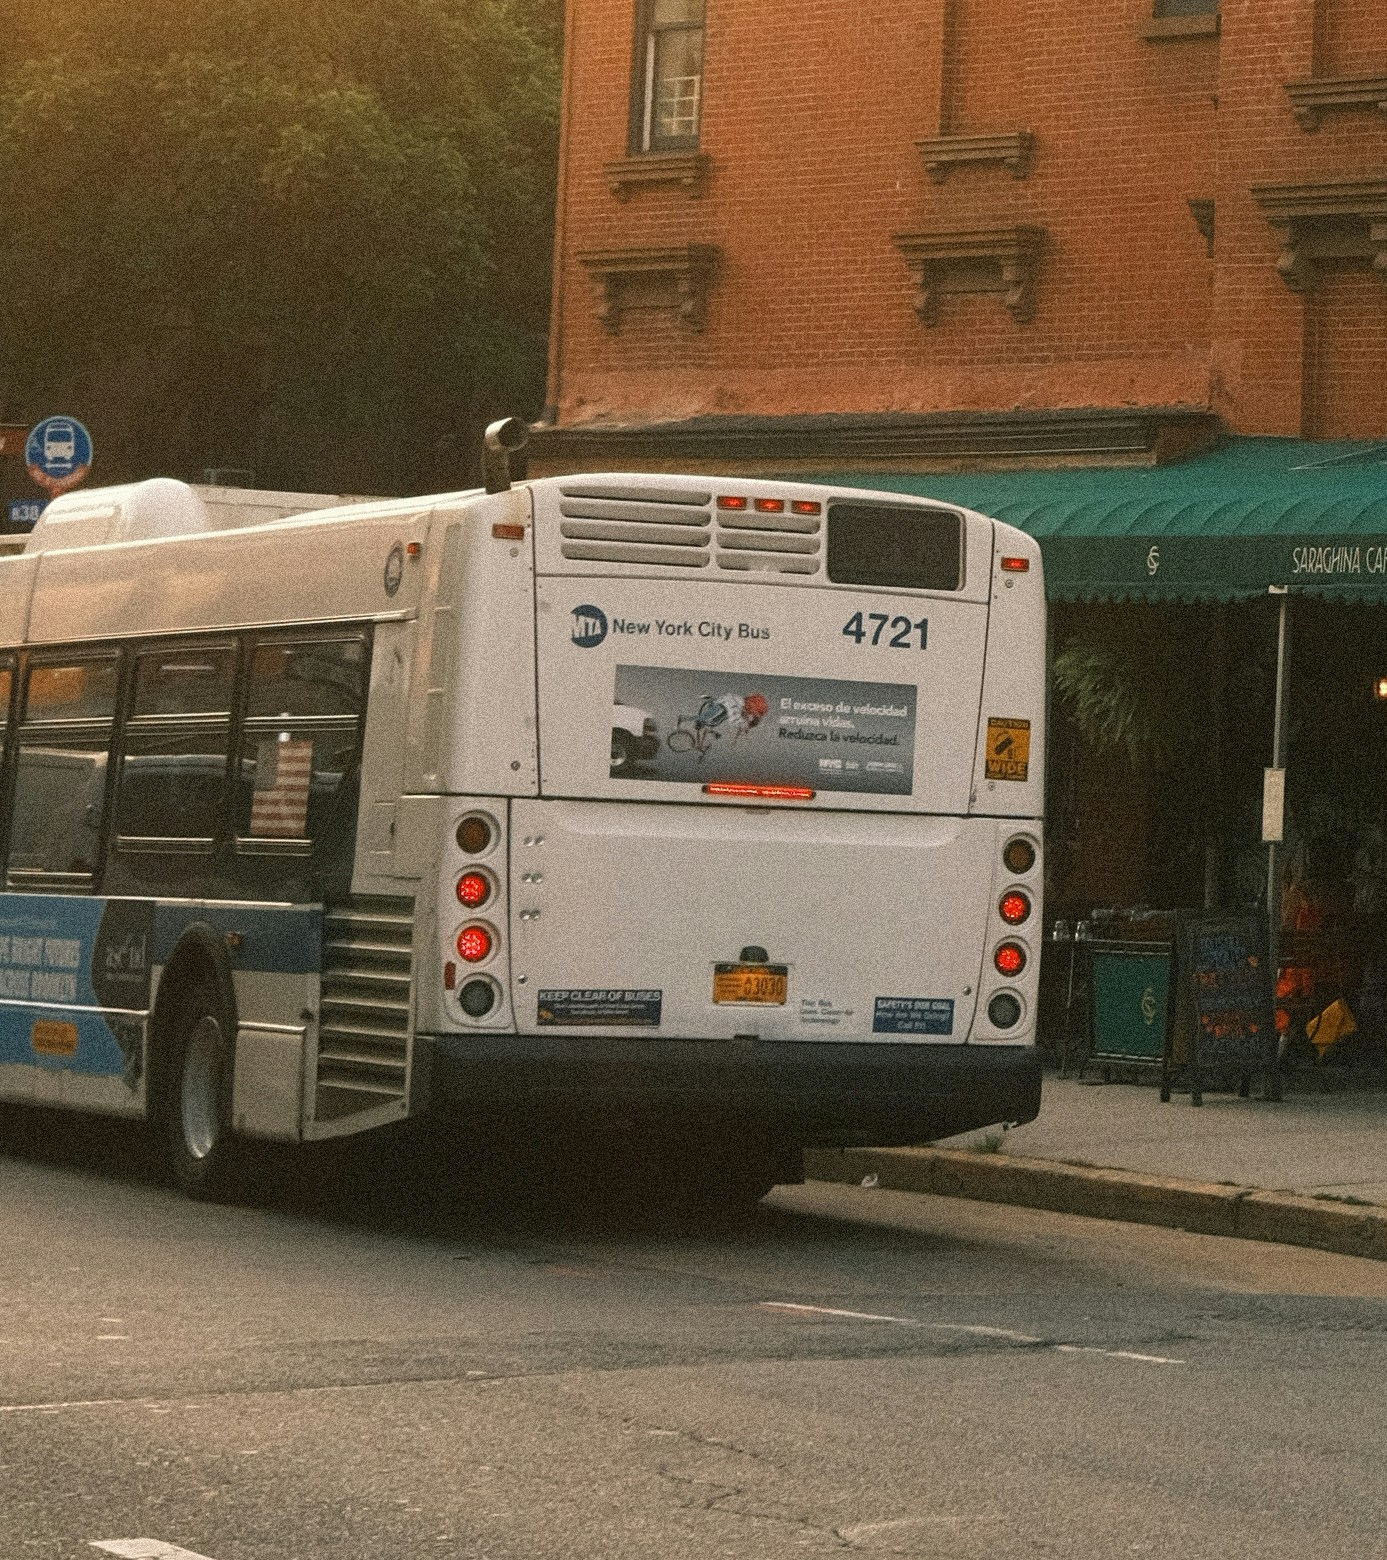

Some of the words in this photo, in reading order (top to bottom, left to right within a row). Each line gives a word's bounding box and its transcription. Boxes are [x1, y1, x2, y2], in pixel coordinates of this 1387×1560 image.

[1292, 546, 1361, 574] SARAGHINA
[612, 618, 651, 635] New
[655, 619, 692, 636] York
[698, 621, 733, 641] City
[738, 624, 770, 640] Bus
[841, 611, 930, 650] 4721
[780, 697, 792, 709] El
[835, 701, 852, 714] de
[853, 703, 908, 718] velocidad
[779, 727, 828, 741] Reduzca
[539, 991, 569, 1001] KEEP
[570, 991, 607, 1001] CLEAR
[608, 991, 622, 1001] OF
[624, 991, 661, 1001] BUSES
